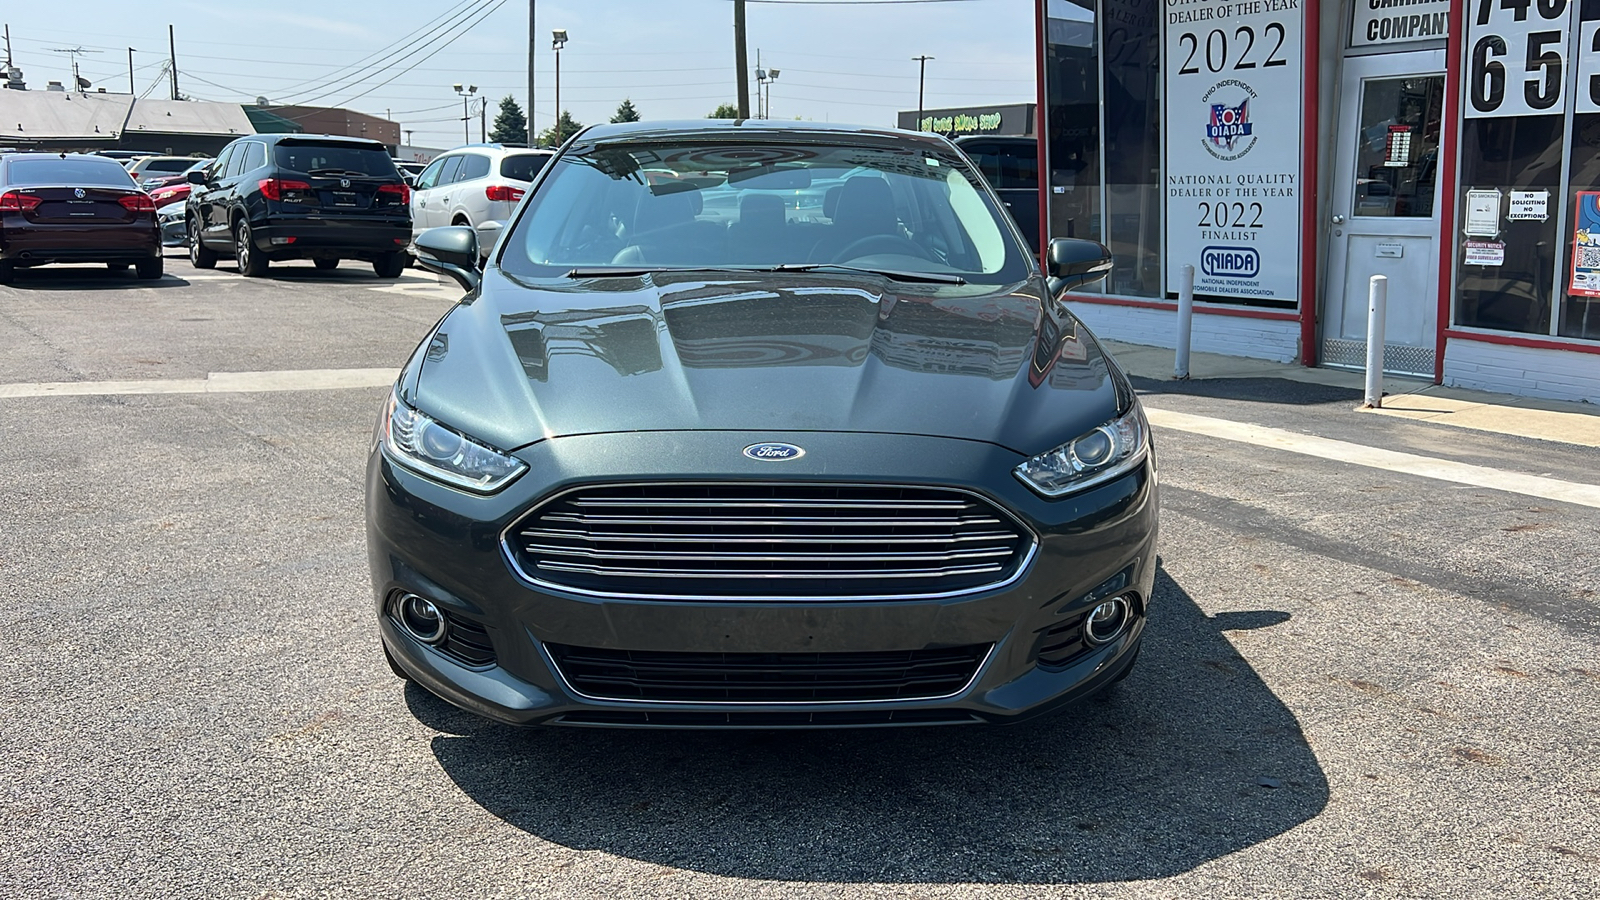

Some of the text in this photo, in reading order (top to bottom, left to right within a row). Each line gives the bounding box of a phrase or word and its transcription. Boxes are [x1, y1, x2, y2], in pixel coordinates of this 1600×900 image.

[1169, 7, 1214, 25] DEALER
[1216, 4, 1233, 19] OF
[1235, 1, 1261, 16] THE
[1264, 0, 1298, 13] YEAR
[1178, 22, 1287, 75] 2022
[1202, 79, 1258, 103] OHIO INDEPENDENT
[979, 112, 1001, 130] SHOP
[1211, 124, 1245, 137] OIADA
[1169, 174, 1296, 186] NATIONAL QUALITY
[1170, 188, 1294, 197] DEALER OF THE YEAR
[1197, 201, 1264, 229] 2022
[1201, 230, 1258, 241] FINALIST
[1205, 252, 1254, 271] NIADA
[1193, 285, 1218, 293] TOMOBILE
[1240, 288, 1275, 296] ASSOCIATION
[756, 445, 791, 457] Ford
